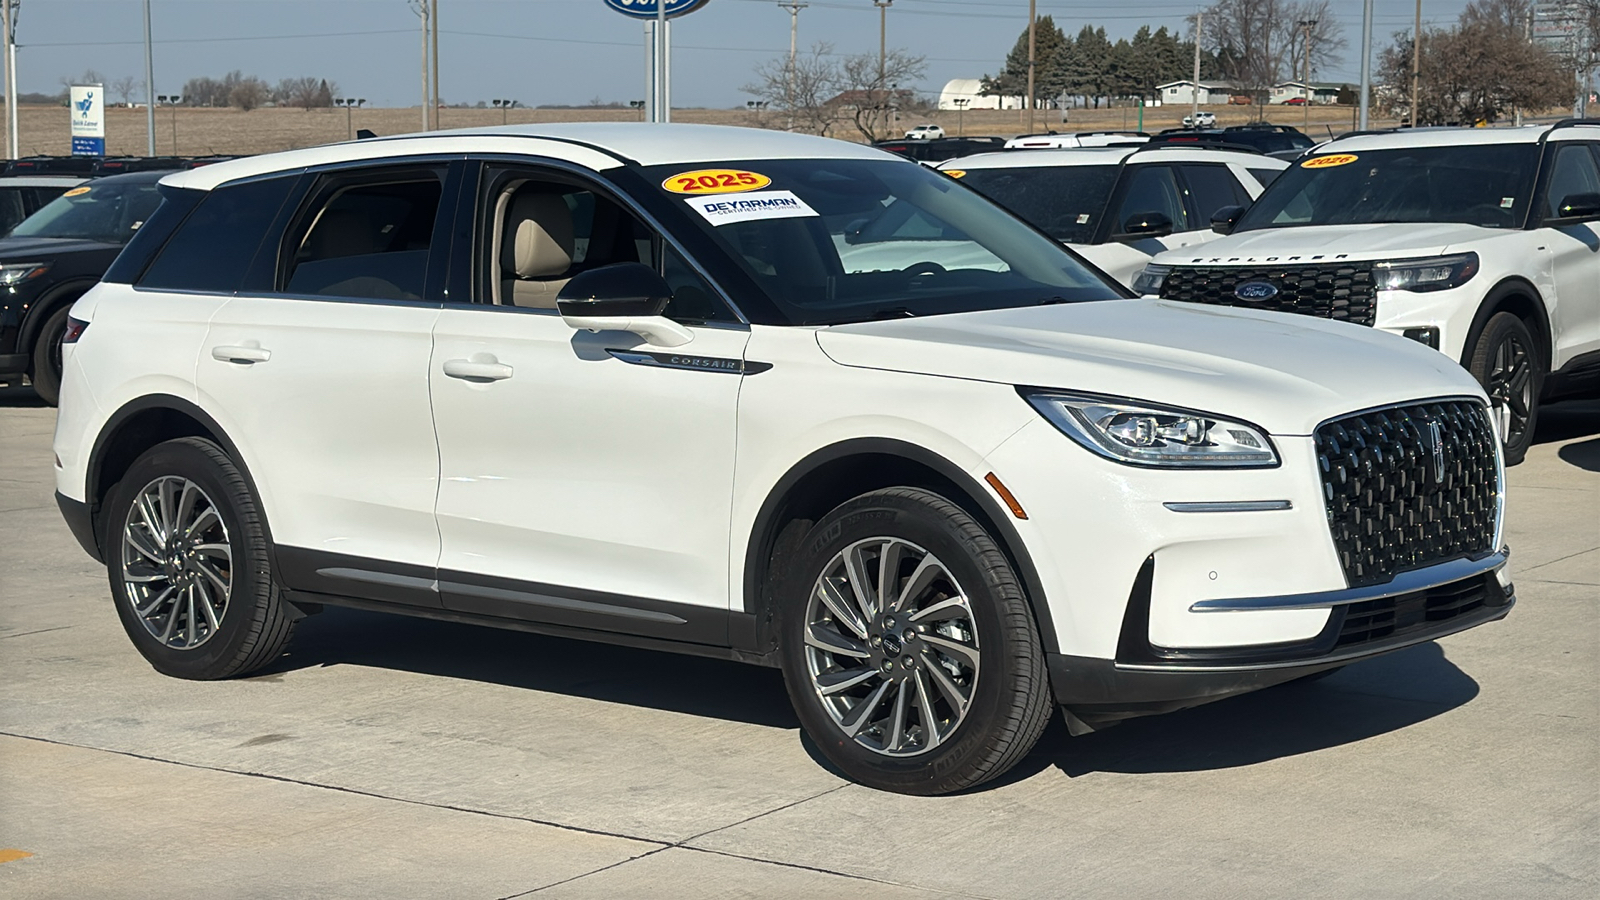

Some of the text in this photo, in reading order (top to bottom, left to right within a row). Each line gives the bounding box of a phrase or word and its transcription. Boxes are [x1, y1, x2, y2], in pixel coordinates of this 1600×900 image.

[1306, 156, 1353, 166] 2026
[677, 173, 759, 191] 2025
[703, 198, 797, 213] DEYARMAN
[718, 206, 757, 216] CERTIFIED
[1192, 254, 1348, 263] EXPLORER
[1243, 287, 1267, 297] Ford
[671, 356, 735, 369] CORSAIR
